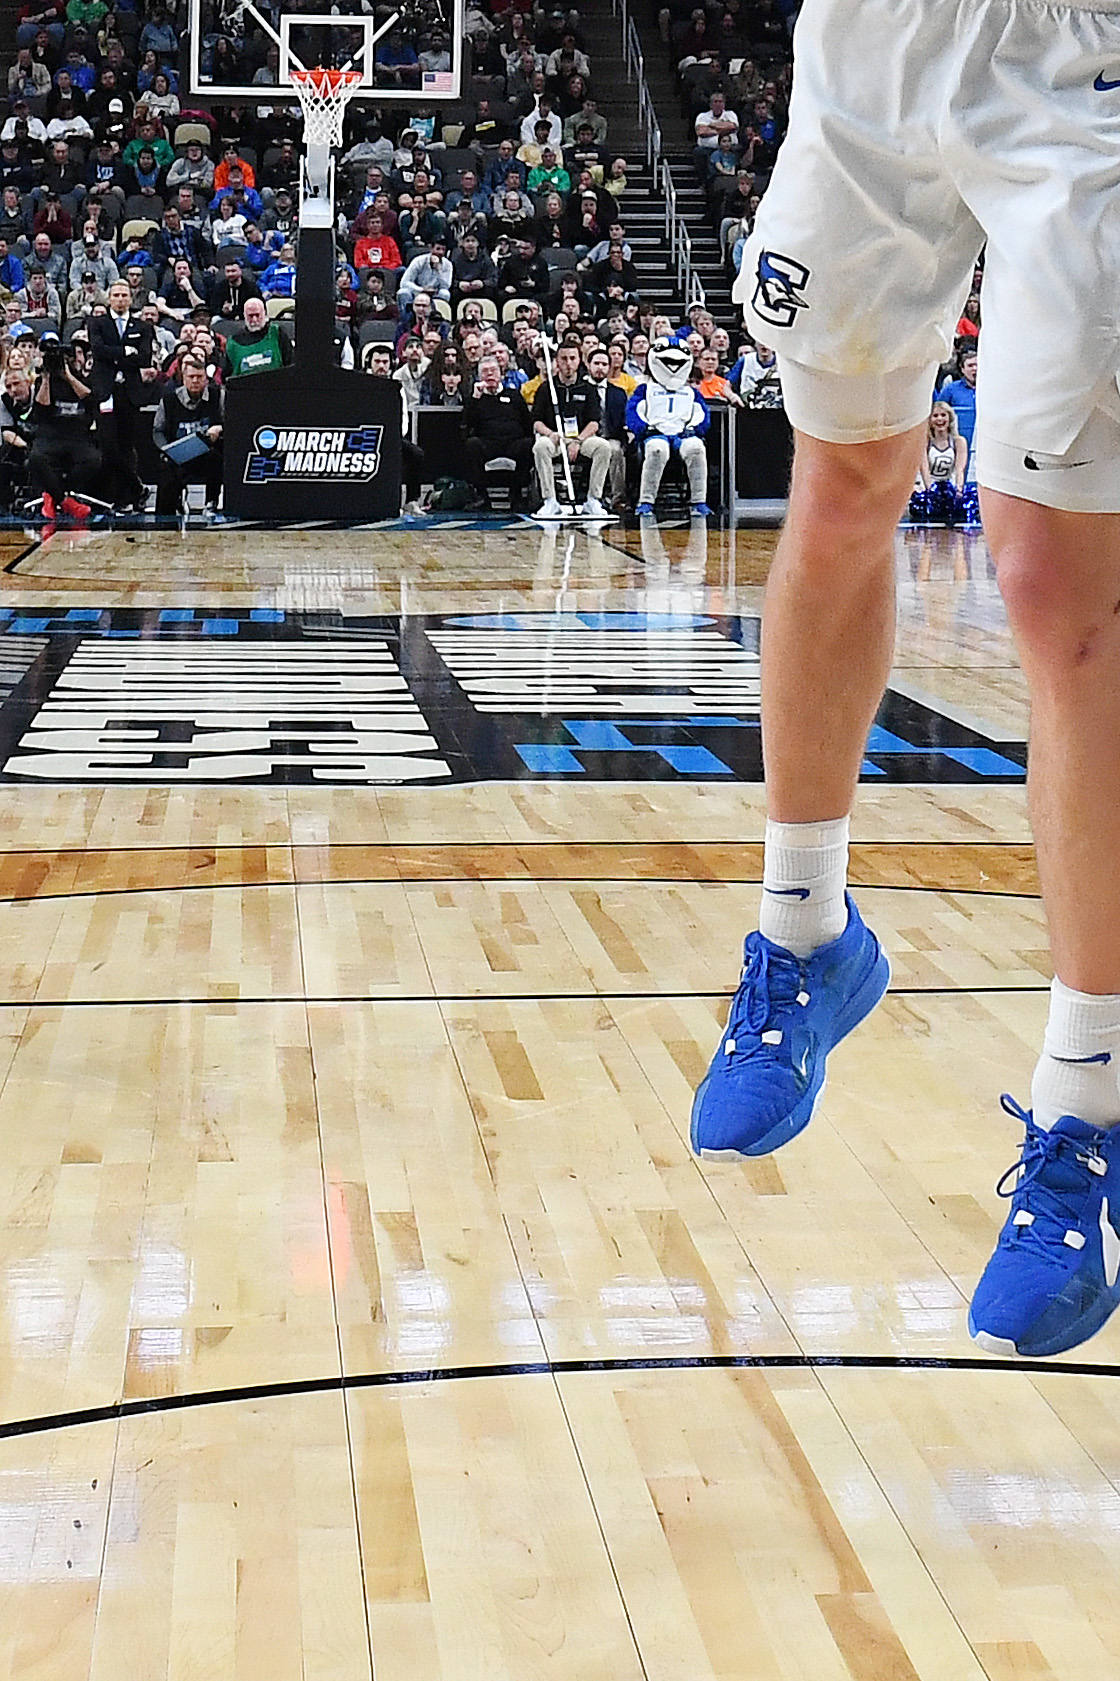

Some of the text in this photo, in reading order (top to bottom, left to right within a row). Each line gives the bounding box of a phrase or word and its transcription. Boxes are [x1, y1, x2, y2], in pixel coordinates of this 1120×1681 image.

[276, 431, 346, 452] MARCH
[283, 451, 377, 473] MADNESS
[929, 456, 953, 477] C
